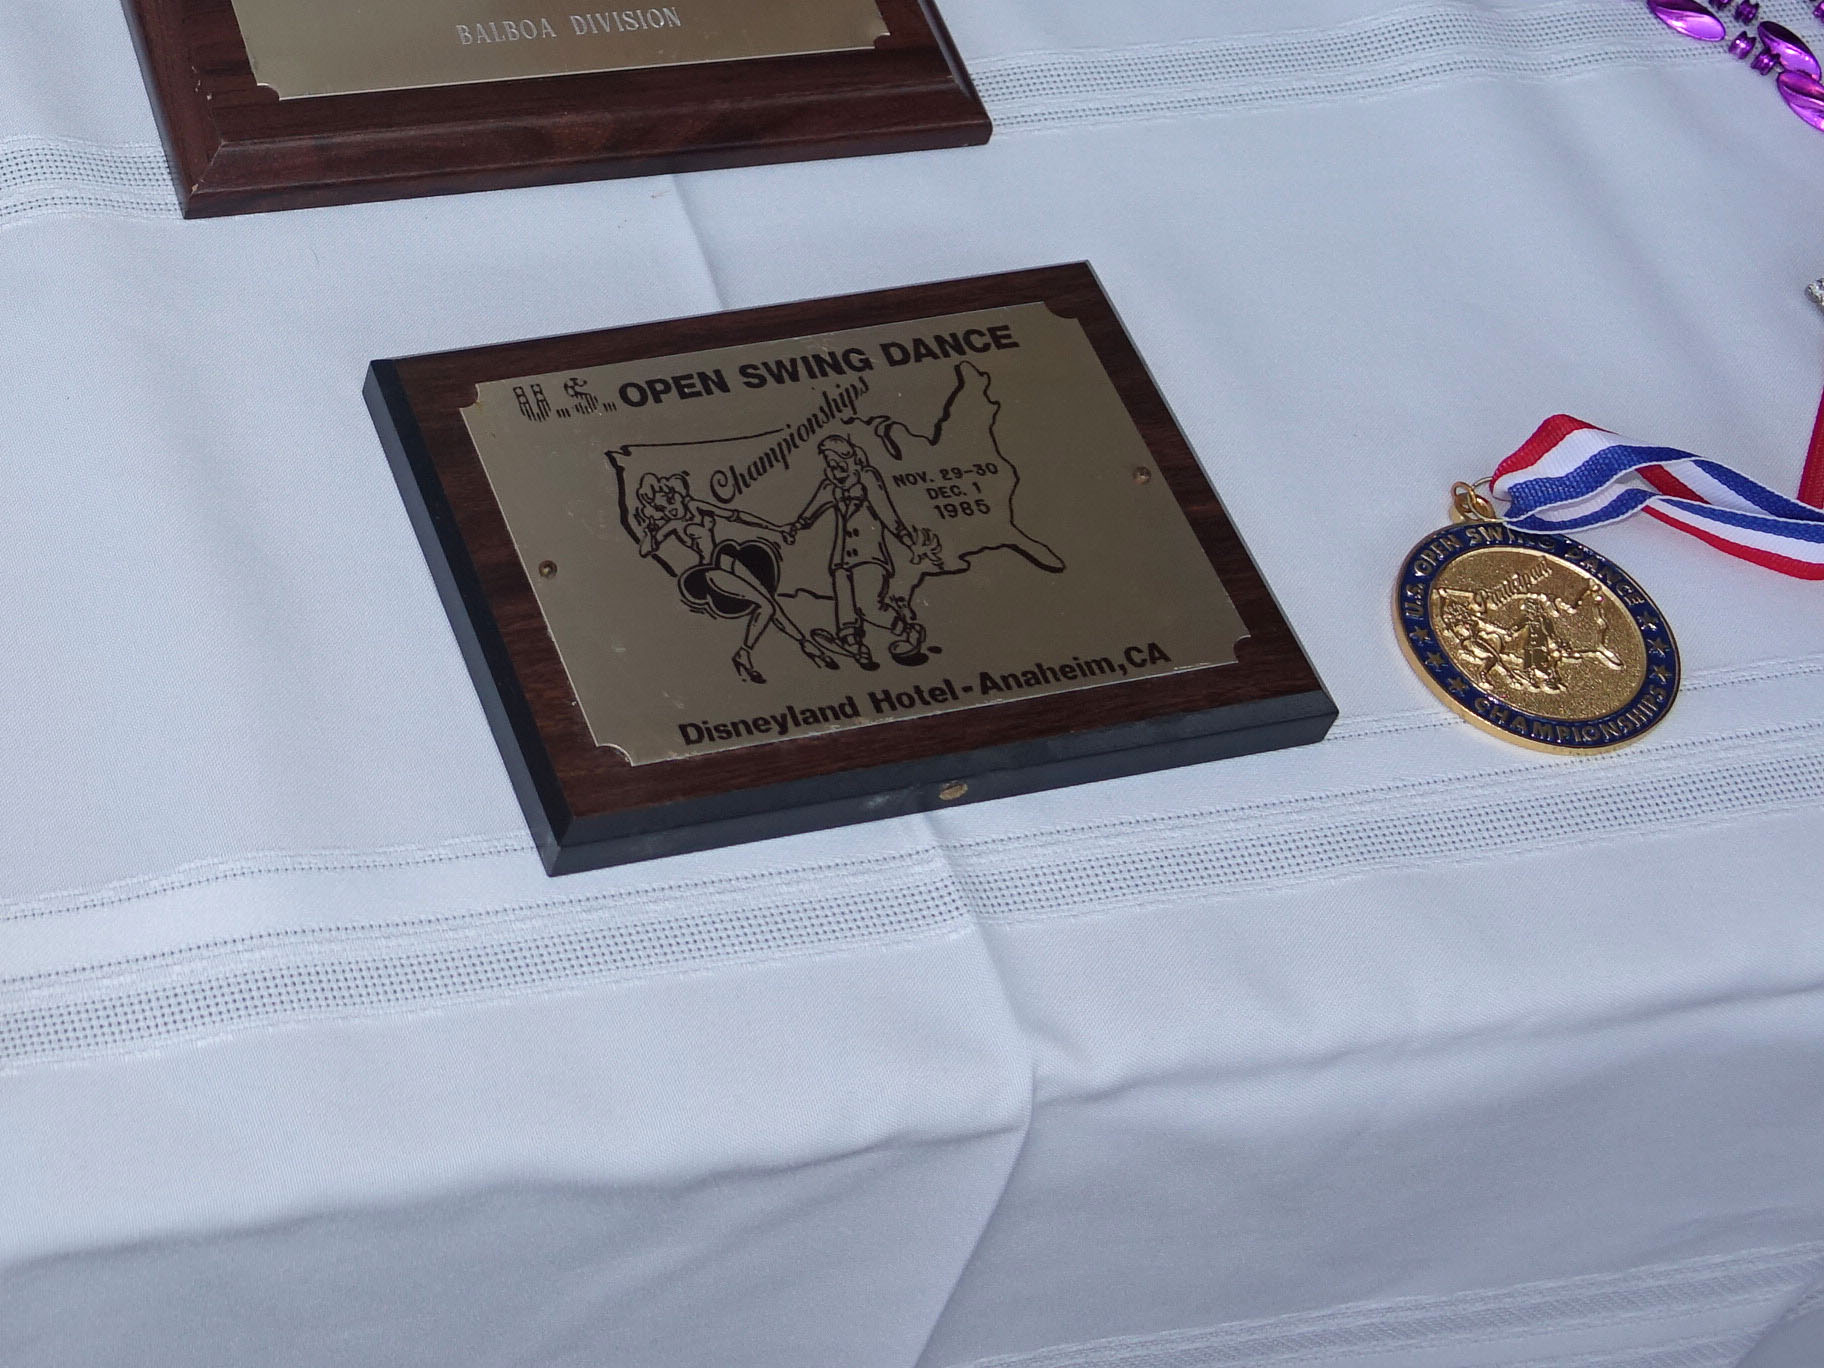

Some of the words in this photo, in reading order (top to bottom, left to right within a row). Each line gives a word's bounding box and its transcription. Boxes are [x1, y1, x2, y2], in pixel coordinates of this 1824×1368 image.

[455, 17, 557, 45] BALBOA
[569, 6, 682, 36] DIVISION
[618, 368, 731, 409] OPEN
[738, 346, 874, 392] SWING
[878, 324, 1021, 368] DANCE
[709, 375, 872, 505] Championships
[892, 471, 936, 489] NOV.
[939, 462, 999, 481] 29-30
[925, 484, 967, 500] DEC.
[972, 481, 982, 494] 1
[933, 498, 991, 520] 1985
[1413, 533, 1465, 578] OPEN
[678, 695, 861, 747] Disneyland
[1474, 683, 1668, 744] CHAMPIONSHIPS
